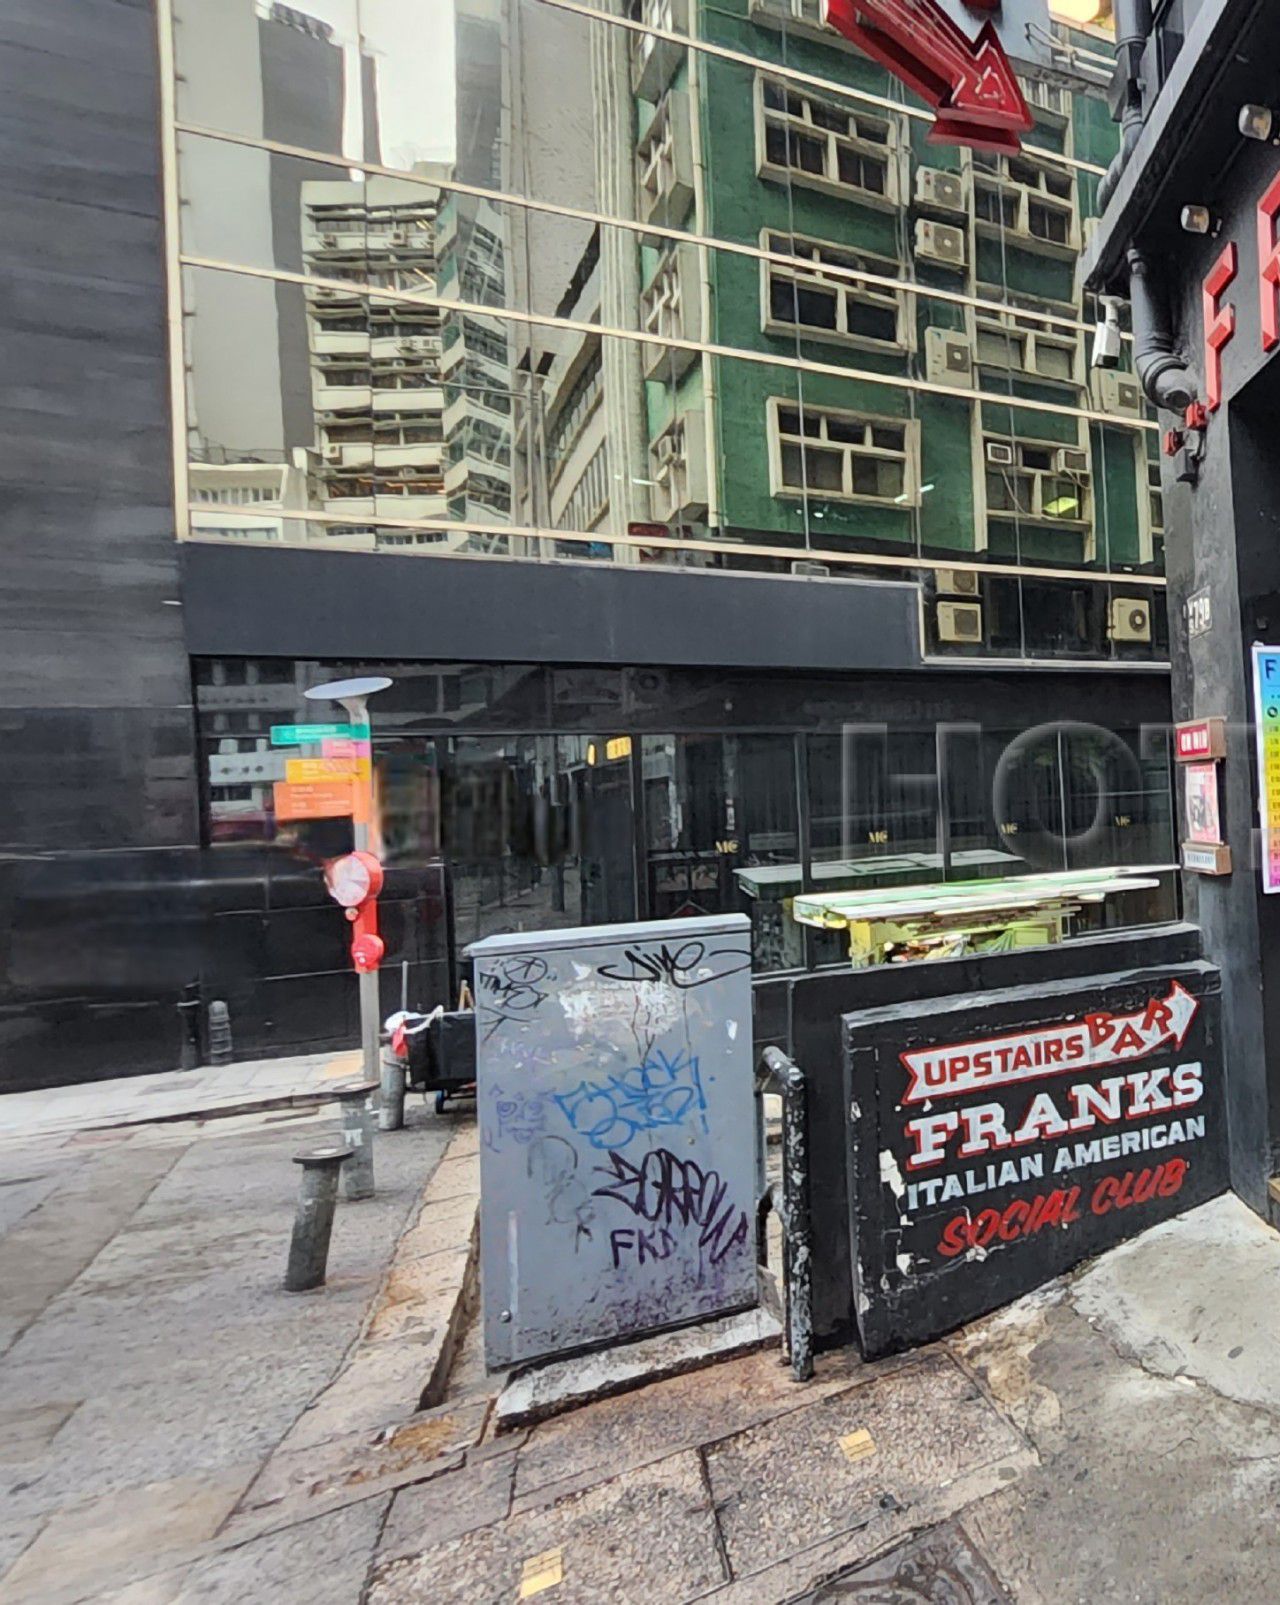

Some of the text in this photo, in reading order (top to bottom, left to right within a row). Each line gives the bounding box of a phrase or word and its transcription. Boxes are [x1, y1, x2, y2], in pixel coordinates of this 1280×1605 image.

[923, 999, 1173, 1086] UPSTAIRS BAR
[905, 1062, 1204, 1170] FRANKS
[907, 1115, 1205, 1210] ITALIAN AMERICAN
[937, 1158, 1187, 1257] SOCIAL CLUB
